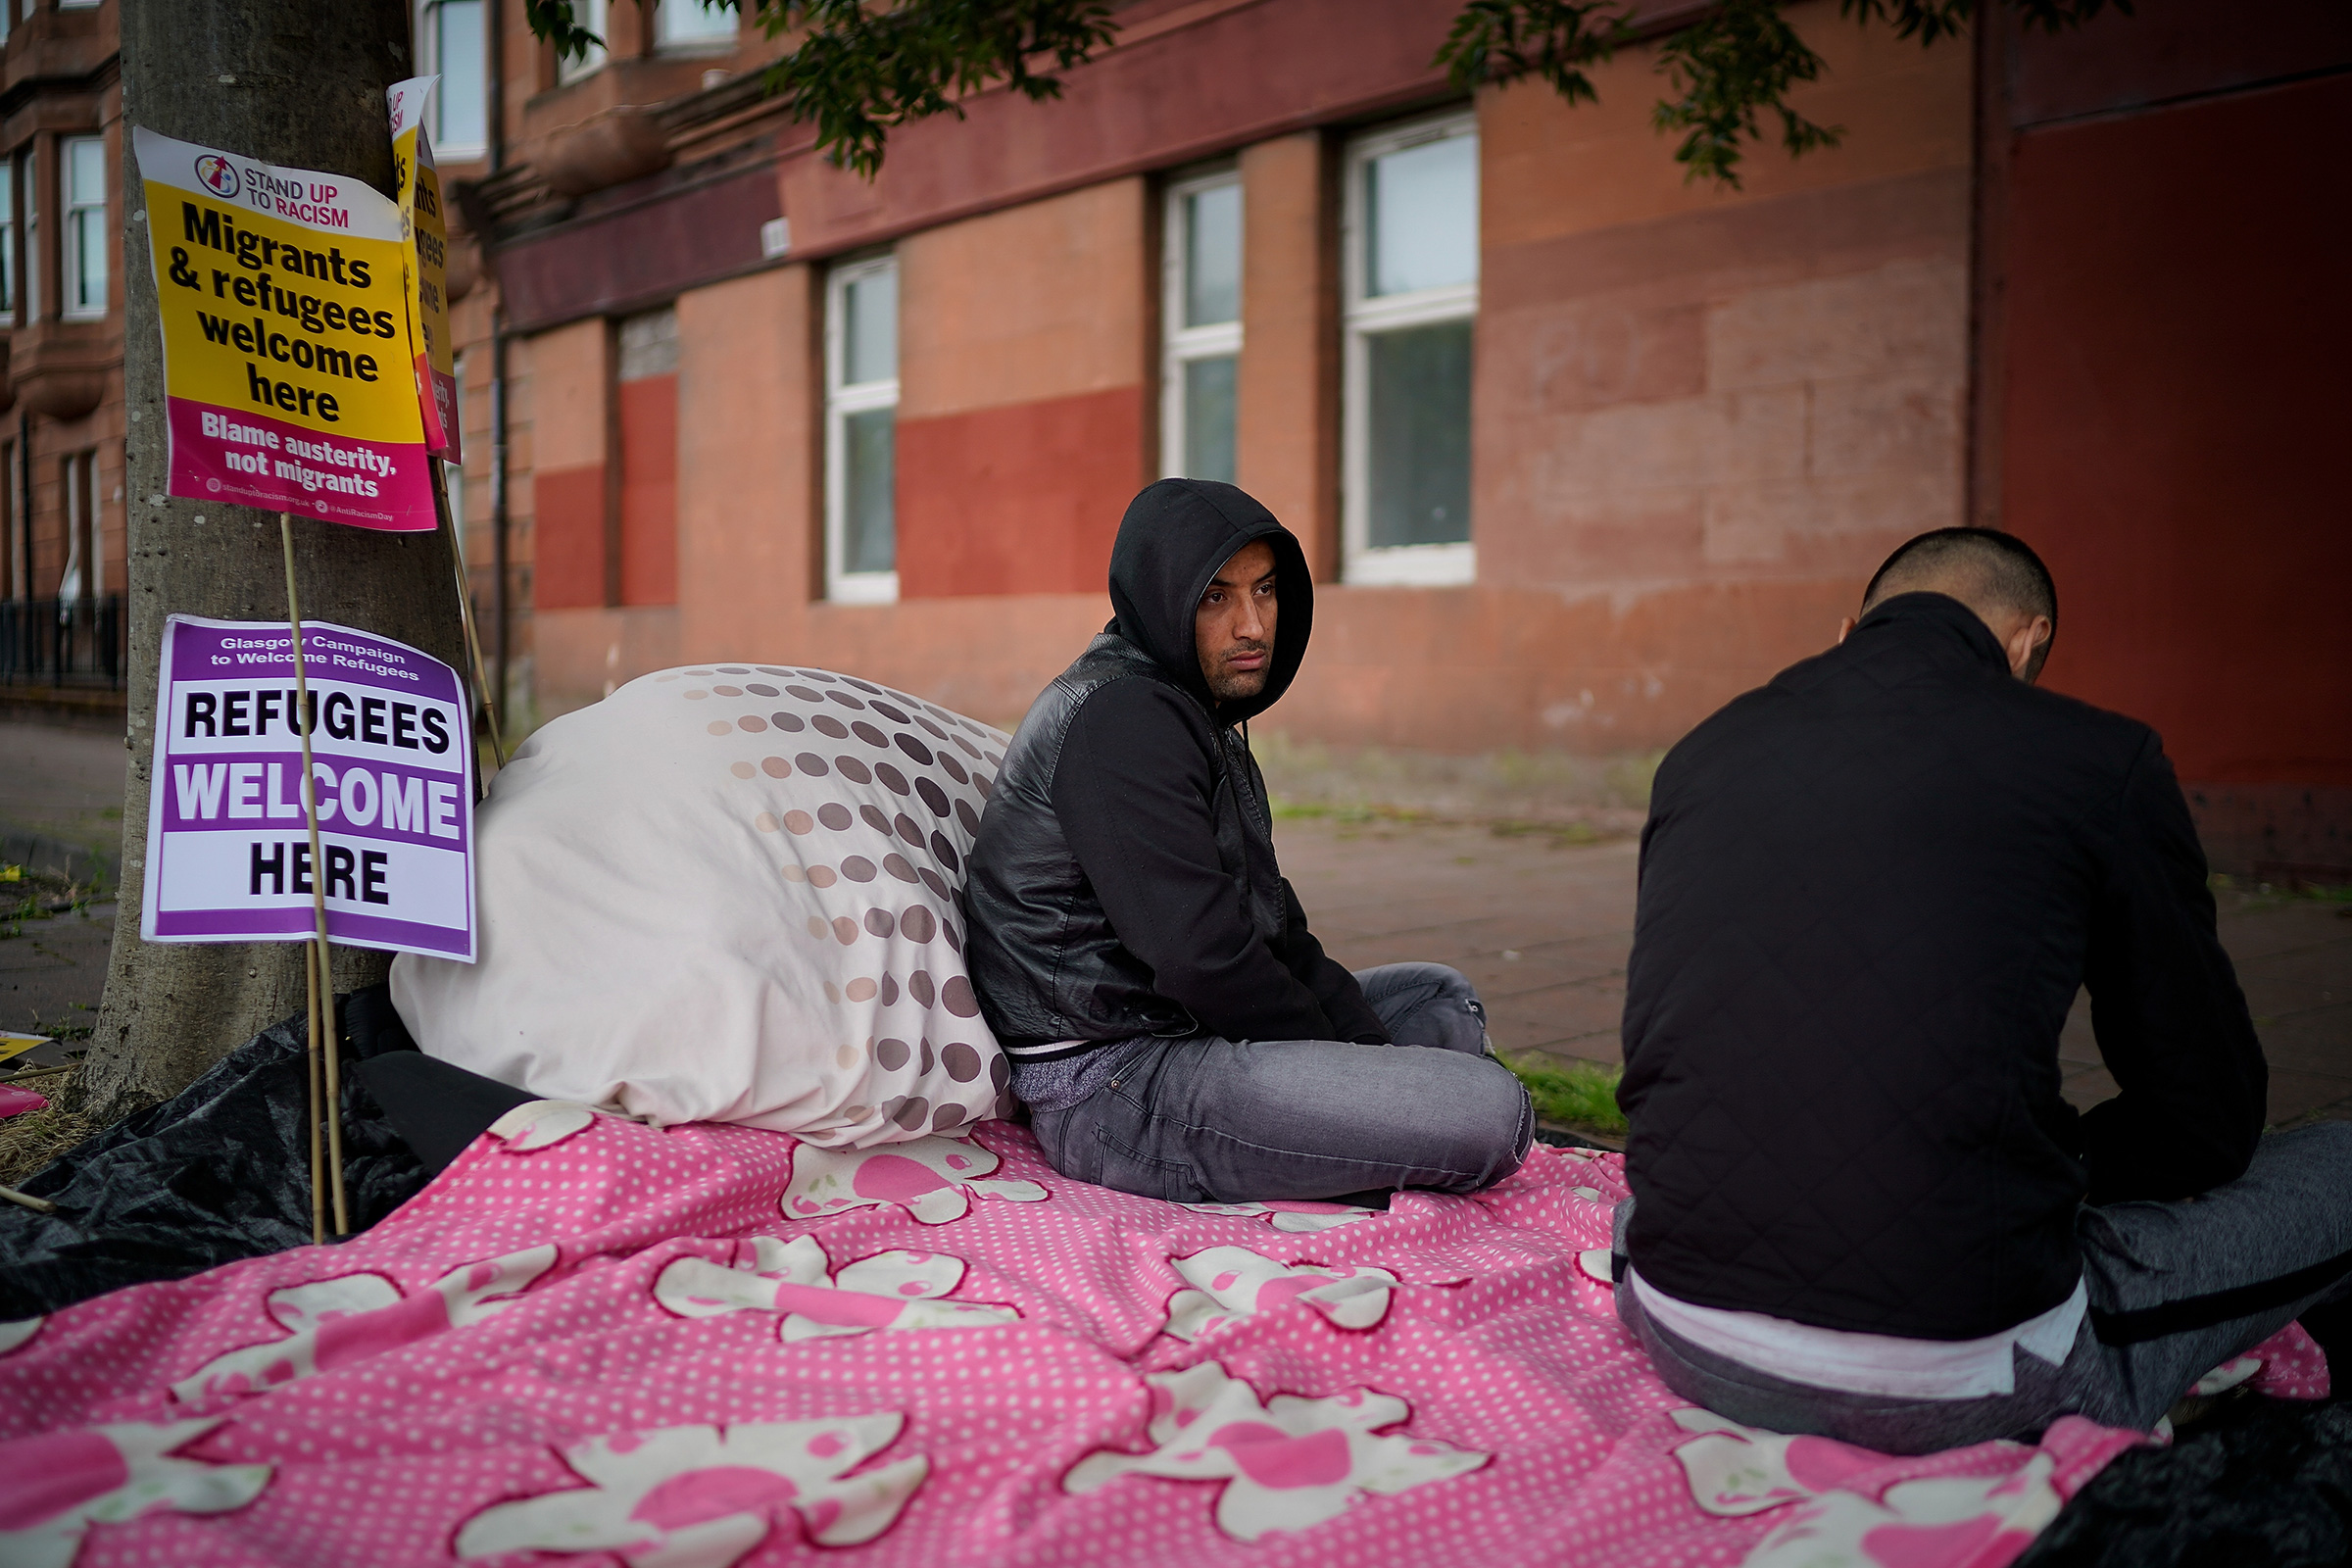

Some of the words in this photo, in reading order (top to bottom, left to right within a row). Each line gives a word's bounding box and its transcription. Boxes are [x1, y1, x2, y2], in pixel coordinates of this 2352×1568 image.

[245, 168, 304, 200] STAND
[309, 183, 338, 205] UP
[247, 187, 271, 210] TO
[275, 199, 349, 229] RACISM
[181, 201, 372, 289] Migrants
[169, 246, 202, 292] &
[211, 268, 396, 340] refugees
[196, 310, 379, 383] welcome
[246, 361, 341, 422] here
[201, 411, 280, 450] Blame
[284, 435, 397, 477] austerity,
[224, 450, 270, 476] not
[274, 460, 379, 498] migrants
[211, 654, 231, 665] to
[236, 652, 327, 665] Welcome
[332, 654, 420, 682] Refugees
[312, 635, 406, 665] Campaign
[184, 689, 450, 755] REFUGEES
[172, 761, 461, 841] WELCOME
[250, 840, 390, 906] HERE
